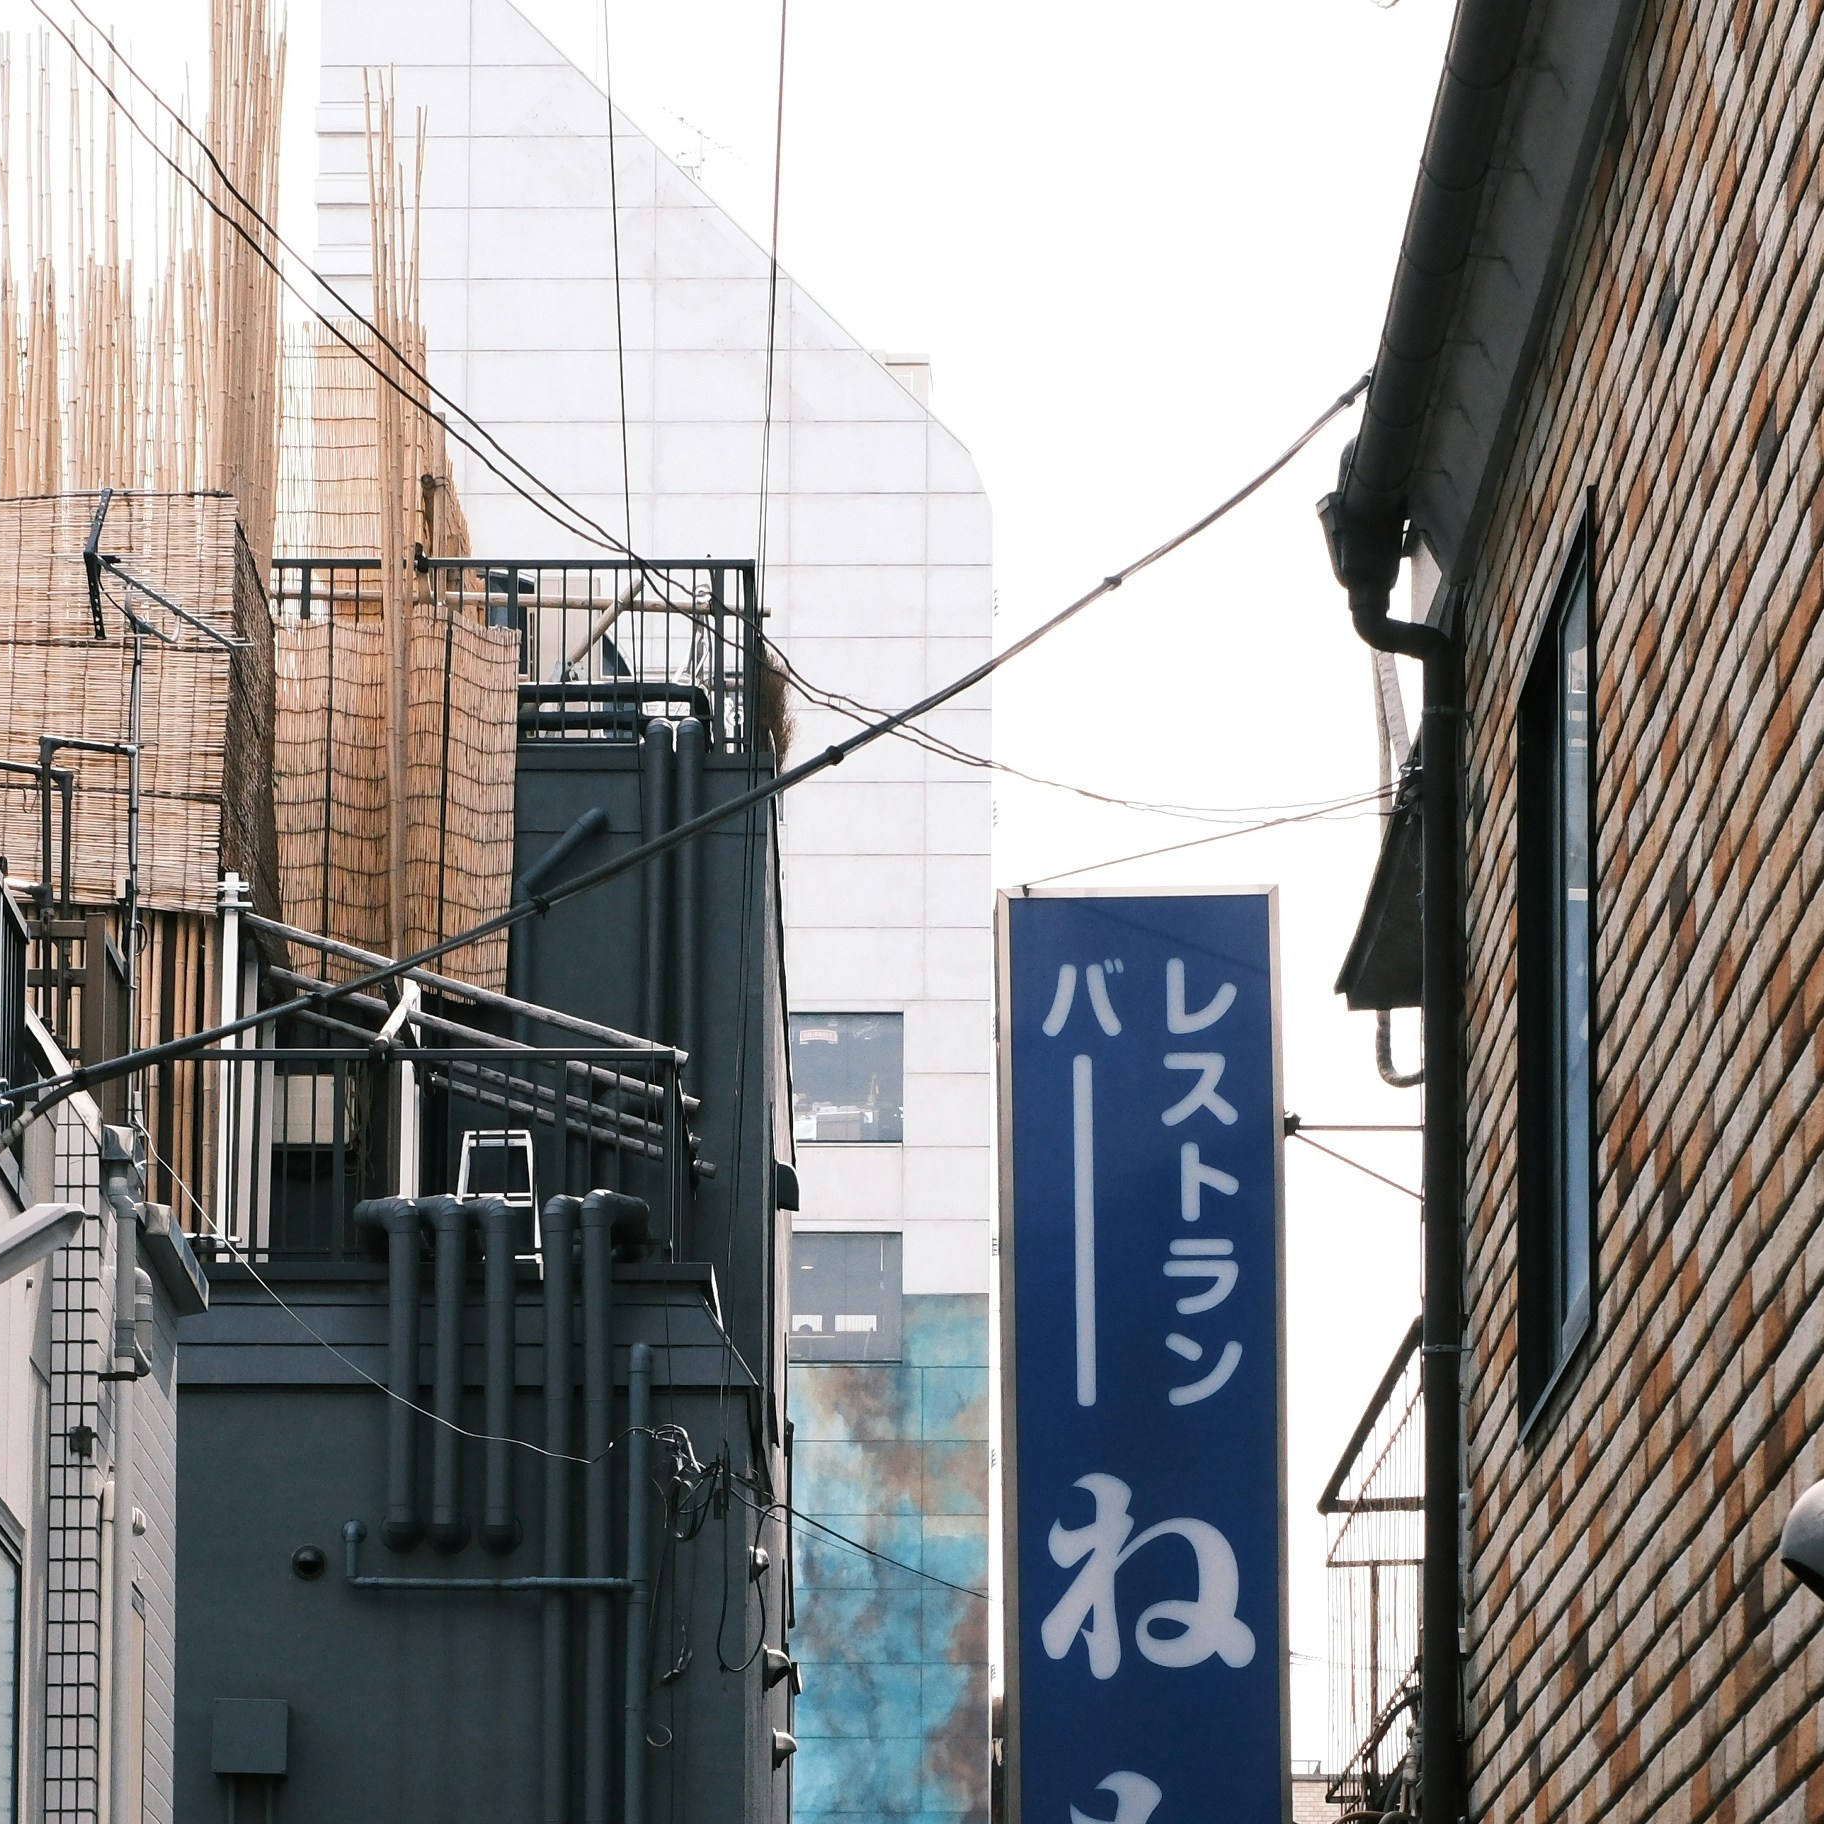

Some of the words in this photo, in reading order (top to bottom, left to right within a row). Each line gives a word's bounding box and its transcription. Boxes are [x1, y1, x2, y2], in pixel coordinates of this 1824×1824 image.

[1042, 957, 1124, 1407] バー
[1161, 957, 1243, 1407] レストラン
